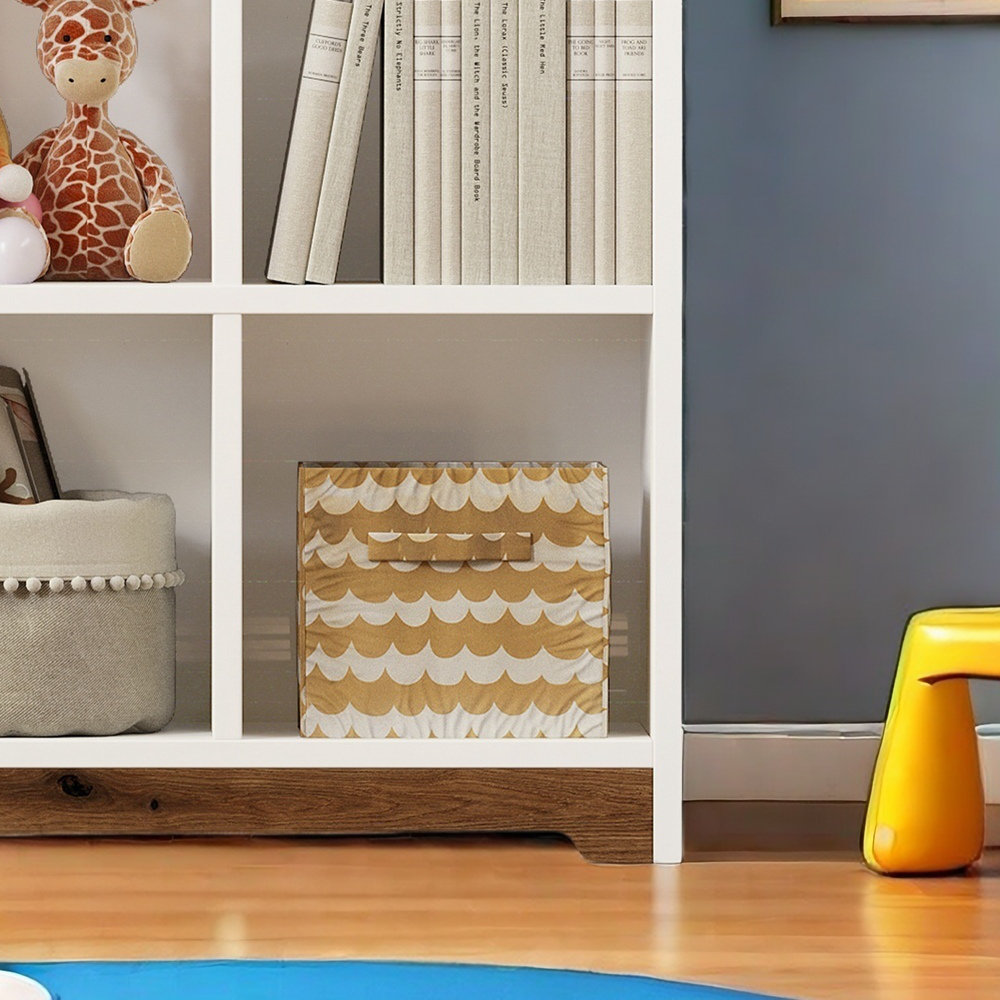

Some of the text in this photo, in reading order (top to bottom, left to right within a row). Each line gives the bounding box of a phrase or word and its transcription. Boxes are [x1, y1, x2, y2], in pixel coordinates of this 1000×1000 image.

[473, 1, 481, 16] The
[354, 4, 373, 68] The Three Bears
[539, 13, 547, 41] Little
[394, 1, 403, 92] Strictly No Elephants
[473, 44, 481, 58] the
[501, 2, 509, 109] The Lorax (Classic Seuss)
[539, 43, 547, 58] Red
[473, 61, 481, 84] Witch
[539, 61, 547, 75] Hen
[473, 86, 481, 101] and
[473, 104, 481, 117] the
[473, 120, 481, 156] Wardrobe
[473, 159, 481, 182] Board
[473, 184, 481, 202] Book
